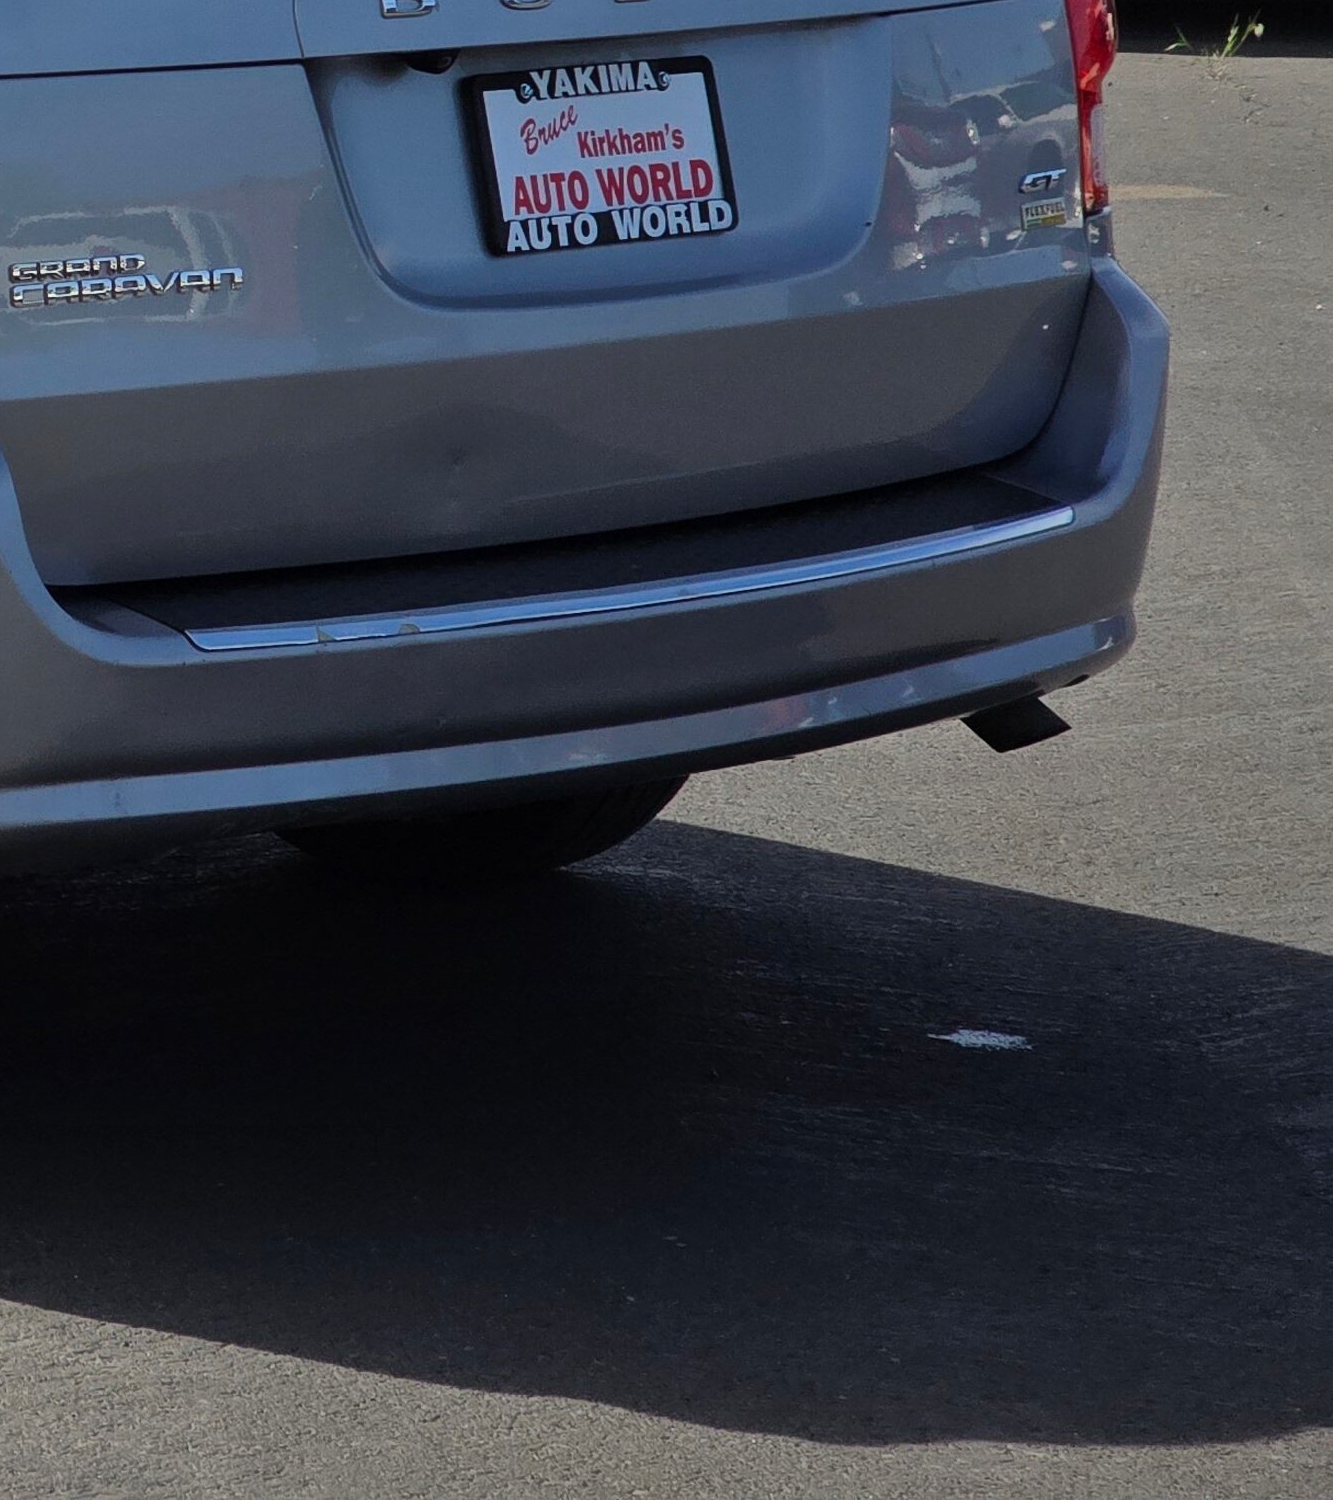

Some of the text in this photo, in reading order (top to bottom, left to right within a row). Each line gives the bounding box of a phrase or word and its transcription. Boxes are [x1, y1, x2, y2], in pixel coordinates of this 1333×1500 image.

[530, 61, 658, 100] YAKIMA
[520, 105, 578, 155] Bruce
[577, 123, 685, 159] Kirkham's
[514, 159, 714, 216] AUTO WORLD
[1019, 167, 1067, 193] GT
[507, 200, 733, 252] AUTO WORLD
[11, 254, 145, 282] GRAND
[11, 267, 243, 307] CARAVAN
